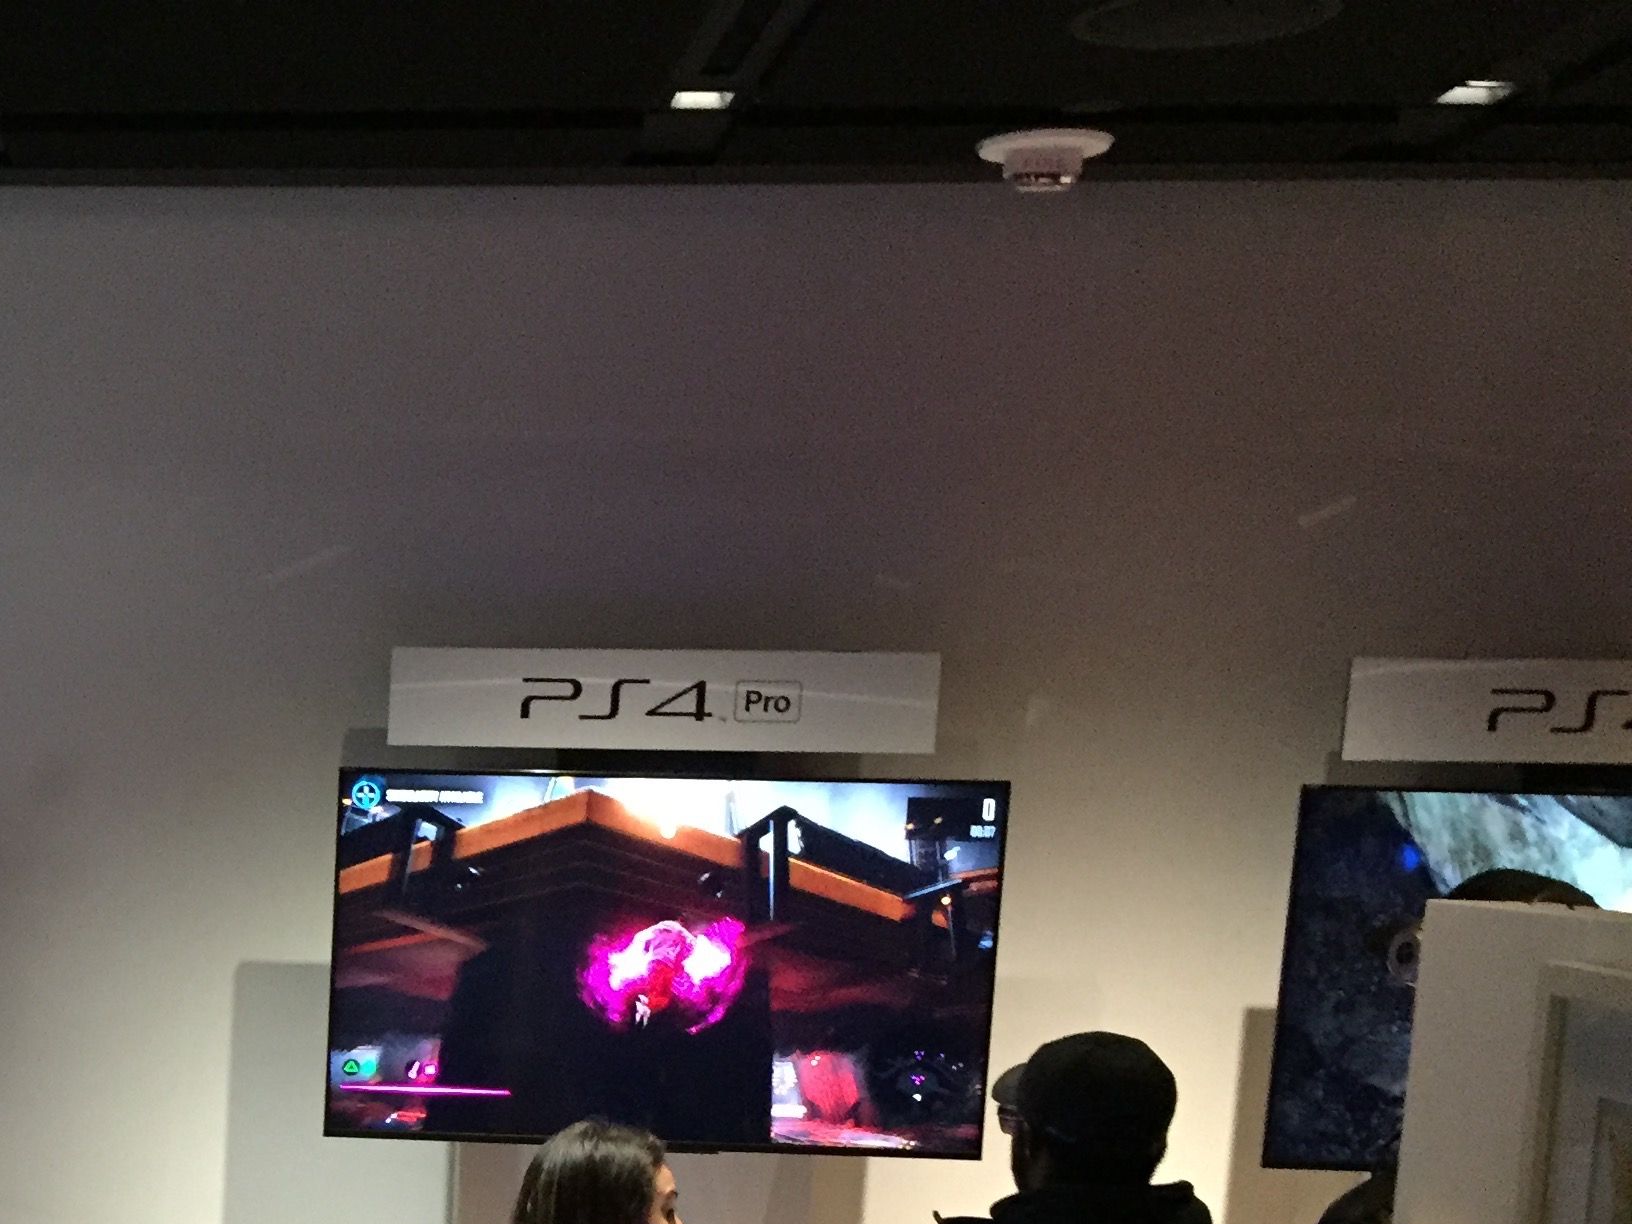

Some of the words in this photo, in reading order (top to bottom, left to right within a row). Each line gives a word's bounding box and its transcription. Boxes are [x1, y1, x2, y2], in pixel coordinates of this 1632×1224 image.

[519, 677, 713, 722] PS4
[744, 689, 792, 714] Pro
[1487, 688, 1632, 734] PS
